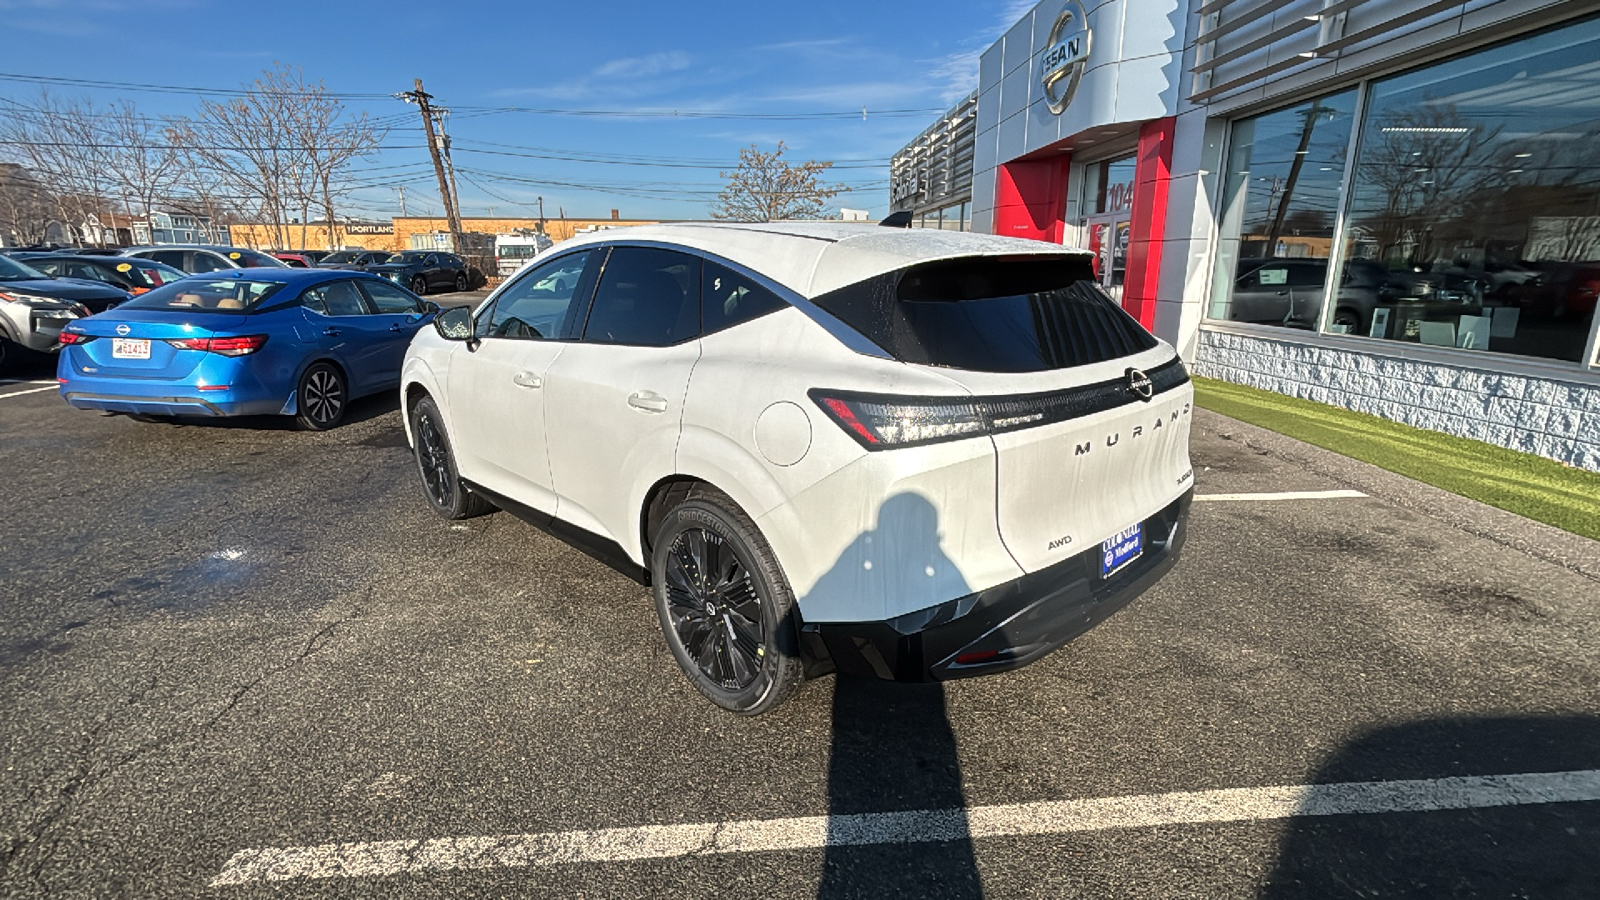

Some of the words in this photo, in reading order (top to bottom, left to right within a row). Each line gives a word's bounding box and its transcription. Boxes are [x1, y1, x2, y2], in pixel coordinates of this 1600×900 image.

[1075, 403, 1190, 456] MURANO
[677, 510, 733, 543] BRIDGESTONE
[1048, 535, 1073, 551] AWD
